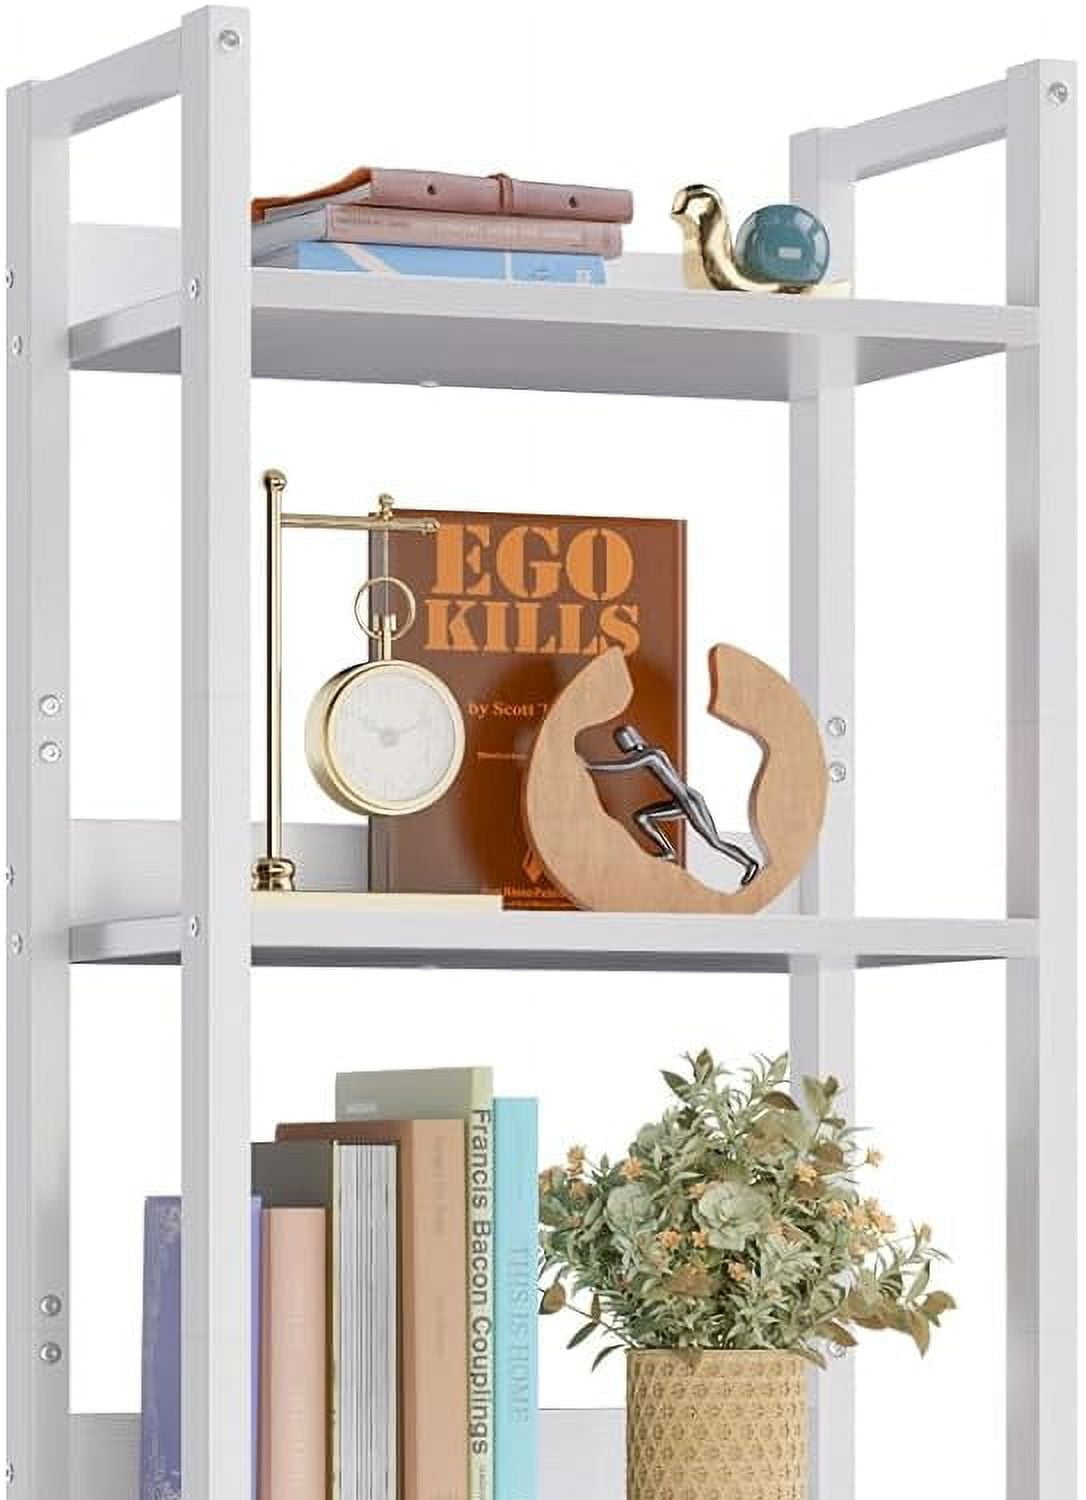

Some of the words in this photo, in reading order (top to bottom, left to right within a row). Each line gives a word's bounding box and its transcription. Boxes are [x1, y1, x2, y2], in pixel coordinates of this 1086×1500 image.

[431, 524, 633, 600] EGO
[424, 599, 641, 656] KILLS
[468, 703, 489, 719] by
[492, 702, 534, 717] Scott
[471, 1109, 492, 1209] Francis
[471, 1220, 492, 1305] Bacon
[510, 1311, 529, 1337] IS
[469, 1316, 492, 1455] Couplings
[510, 1344, 529, 1422] HOME
